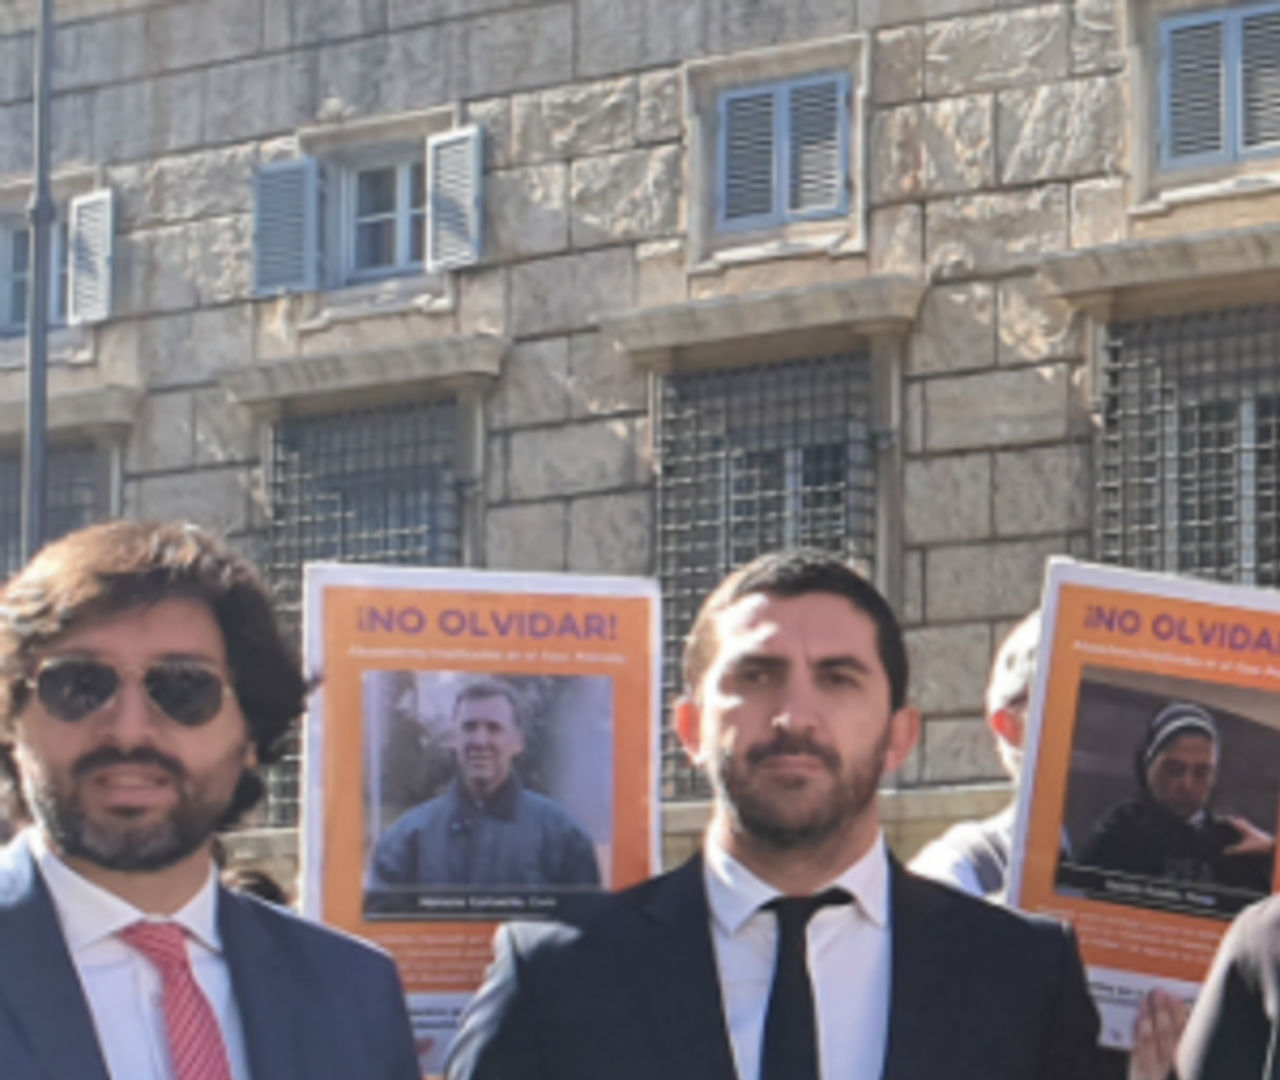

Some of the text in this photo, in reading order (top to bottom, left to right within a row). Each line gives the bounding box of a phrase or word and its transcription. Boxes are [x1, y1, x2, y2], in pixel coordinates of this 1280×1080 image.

[357, 605, 619, 641] ¡NO OLVIDAR!
[1083, 605, 1142, 636] ¡NO
